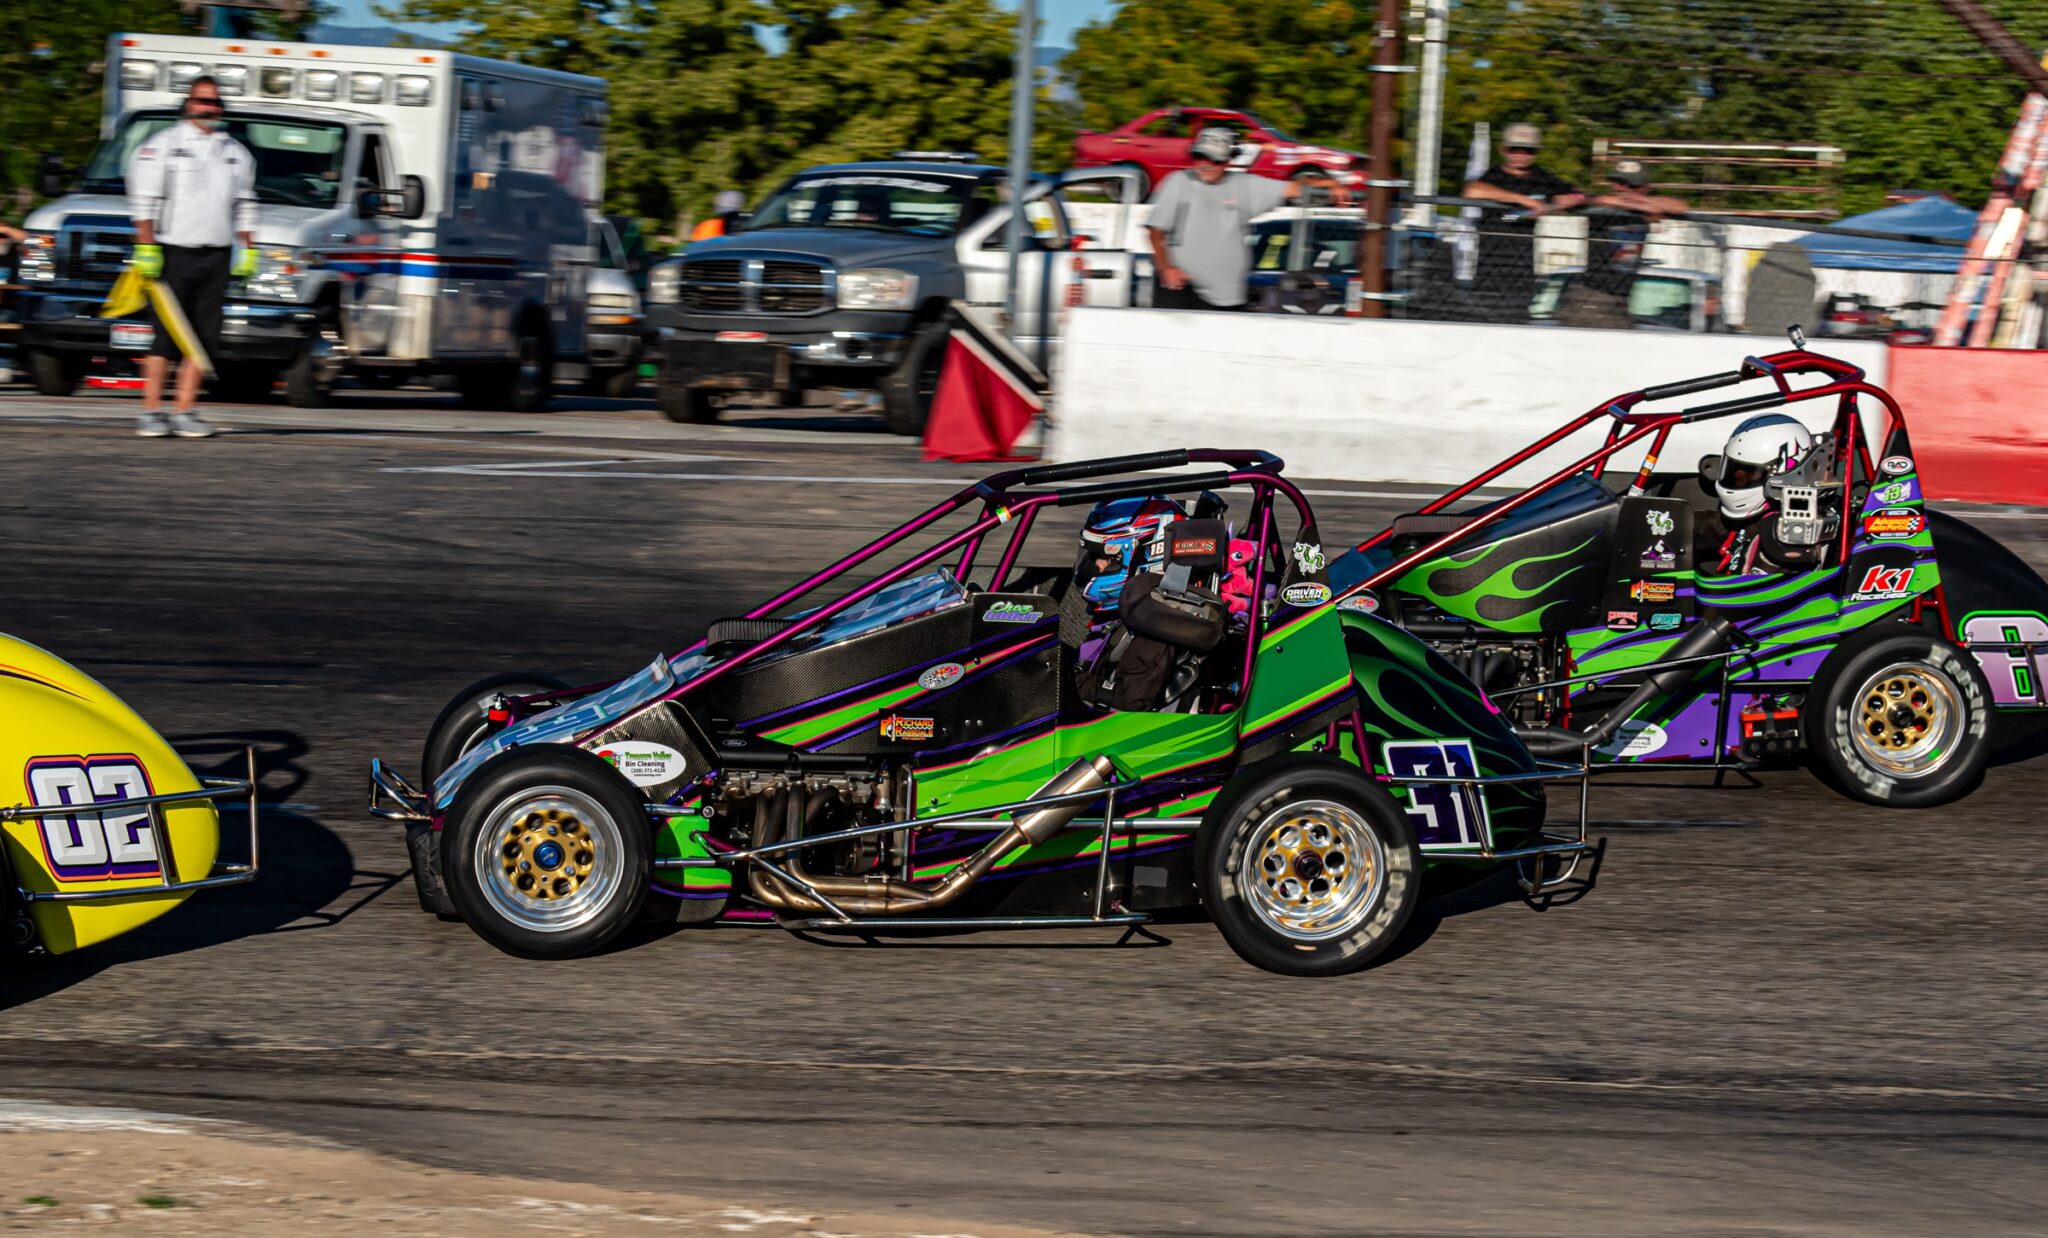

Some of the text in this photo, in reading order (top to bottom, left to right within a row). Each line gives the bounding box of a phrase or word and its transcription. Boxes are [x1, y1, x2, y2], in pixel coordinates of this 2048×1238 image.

[1888, 461, 1908, 471] RAD
[1858, 564, 1915, 593] K1
[1286, 584, 1323, 595] DRIVEN
[1850, 591, 1912, 601] RaceGear
[896, 717, 934, 727] RICHARD
[637, 760, 665, 768] Cleaning
[26, 757, 169, 875] 02
